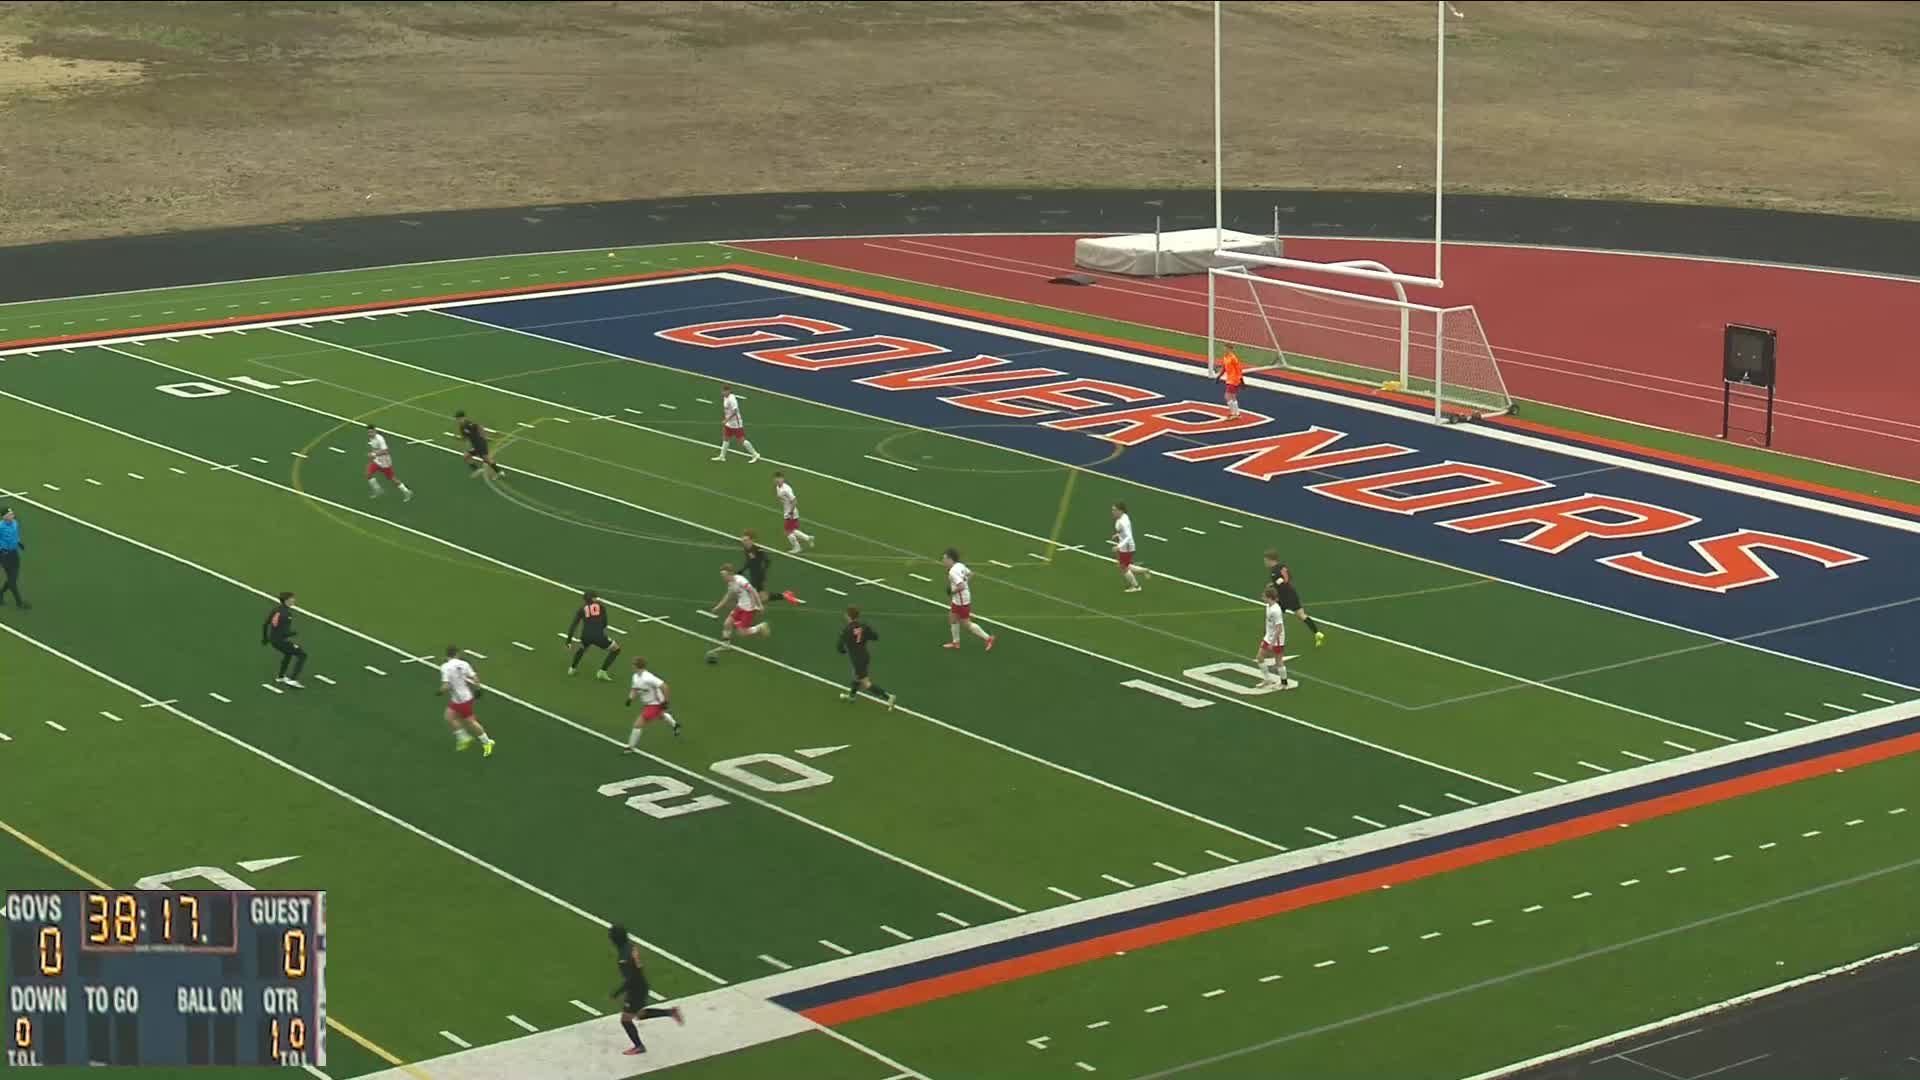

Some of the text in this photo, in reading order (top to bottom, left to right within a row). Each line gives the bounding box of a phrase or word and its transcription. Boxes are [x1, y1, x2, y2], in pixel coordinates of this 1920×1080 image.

[654, 314, 1868, 593] GOVERNORS
[584, 602, 601, 618] 10
[1120, 662, 1299, 709] 10
[597, 753, 834, 819] 20
